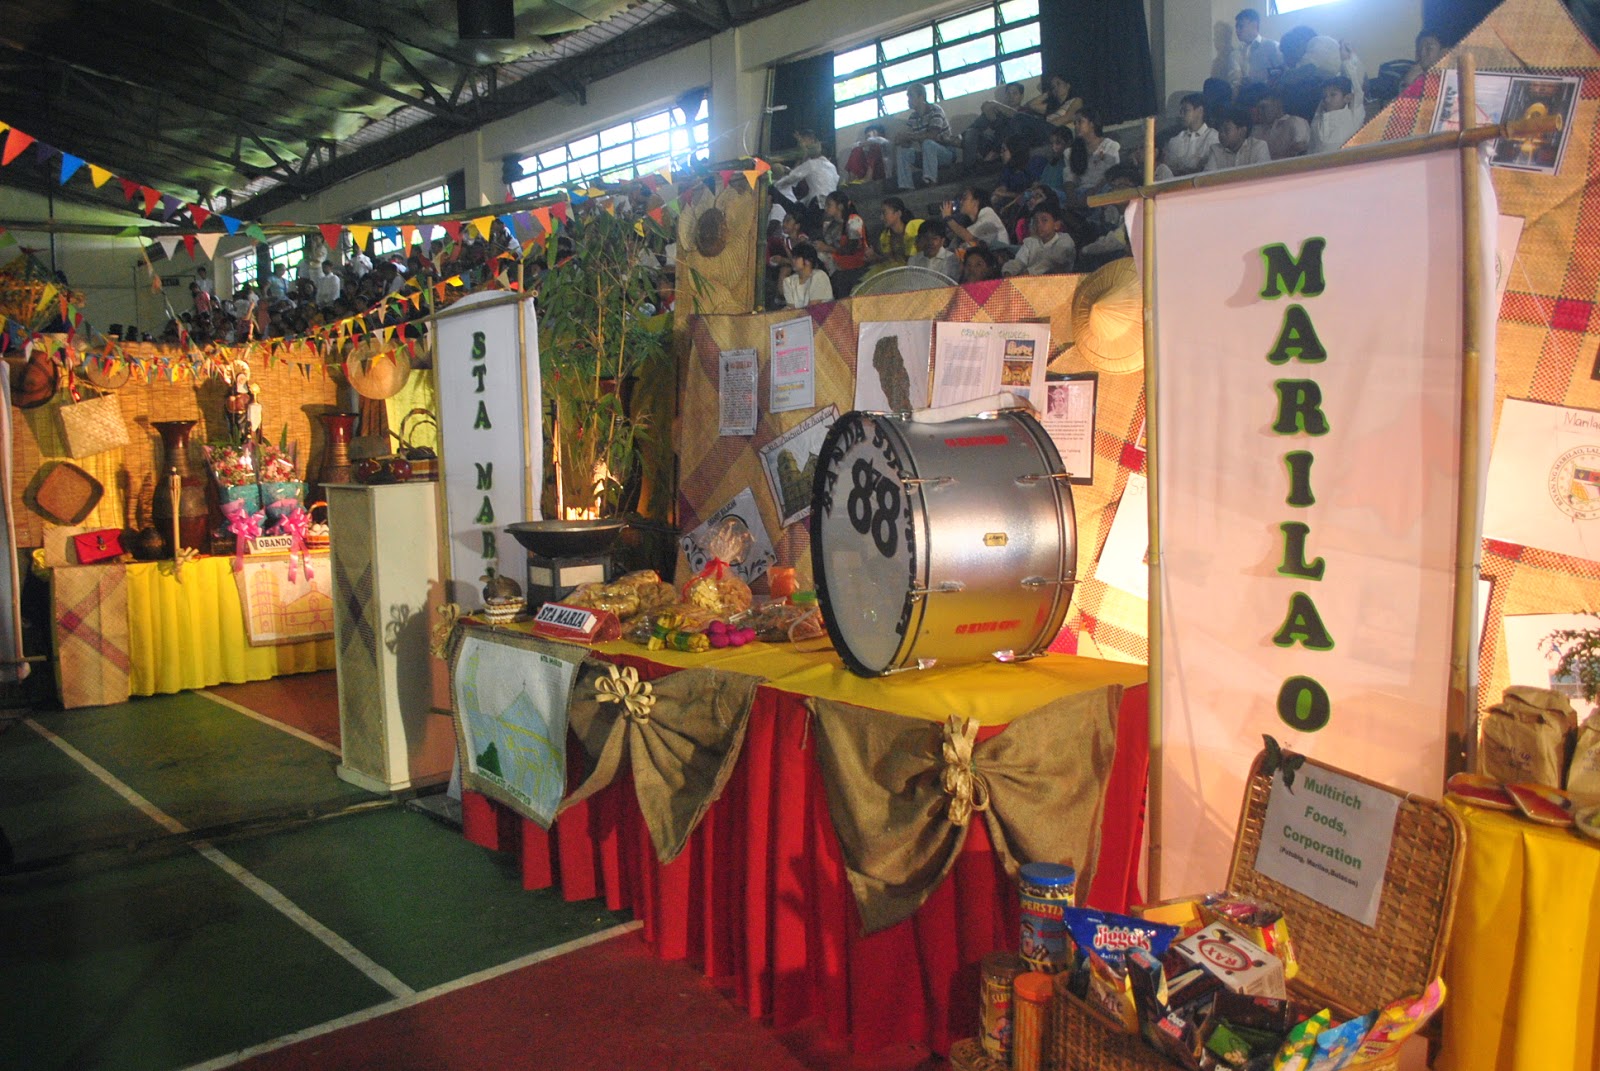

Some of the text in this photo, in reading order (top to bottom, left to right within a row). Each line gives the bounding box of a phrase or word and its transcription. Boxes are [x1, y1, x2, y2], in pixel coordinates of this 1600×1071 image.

[470, 330, 493, 431] STA
[1257, 235, 1335, 734] MARILAO
[258, 537, 292, 550] OBANDO
[537, 605, 587, 628] STA MARIA
[1303, 776, 1362, 811] Multirich
[1303, 804, 1348, 837] Foods,
[1282, 824, 1363, 870] Corporation
